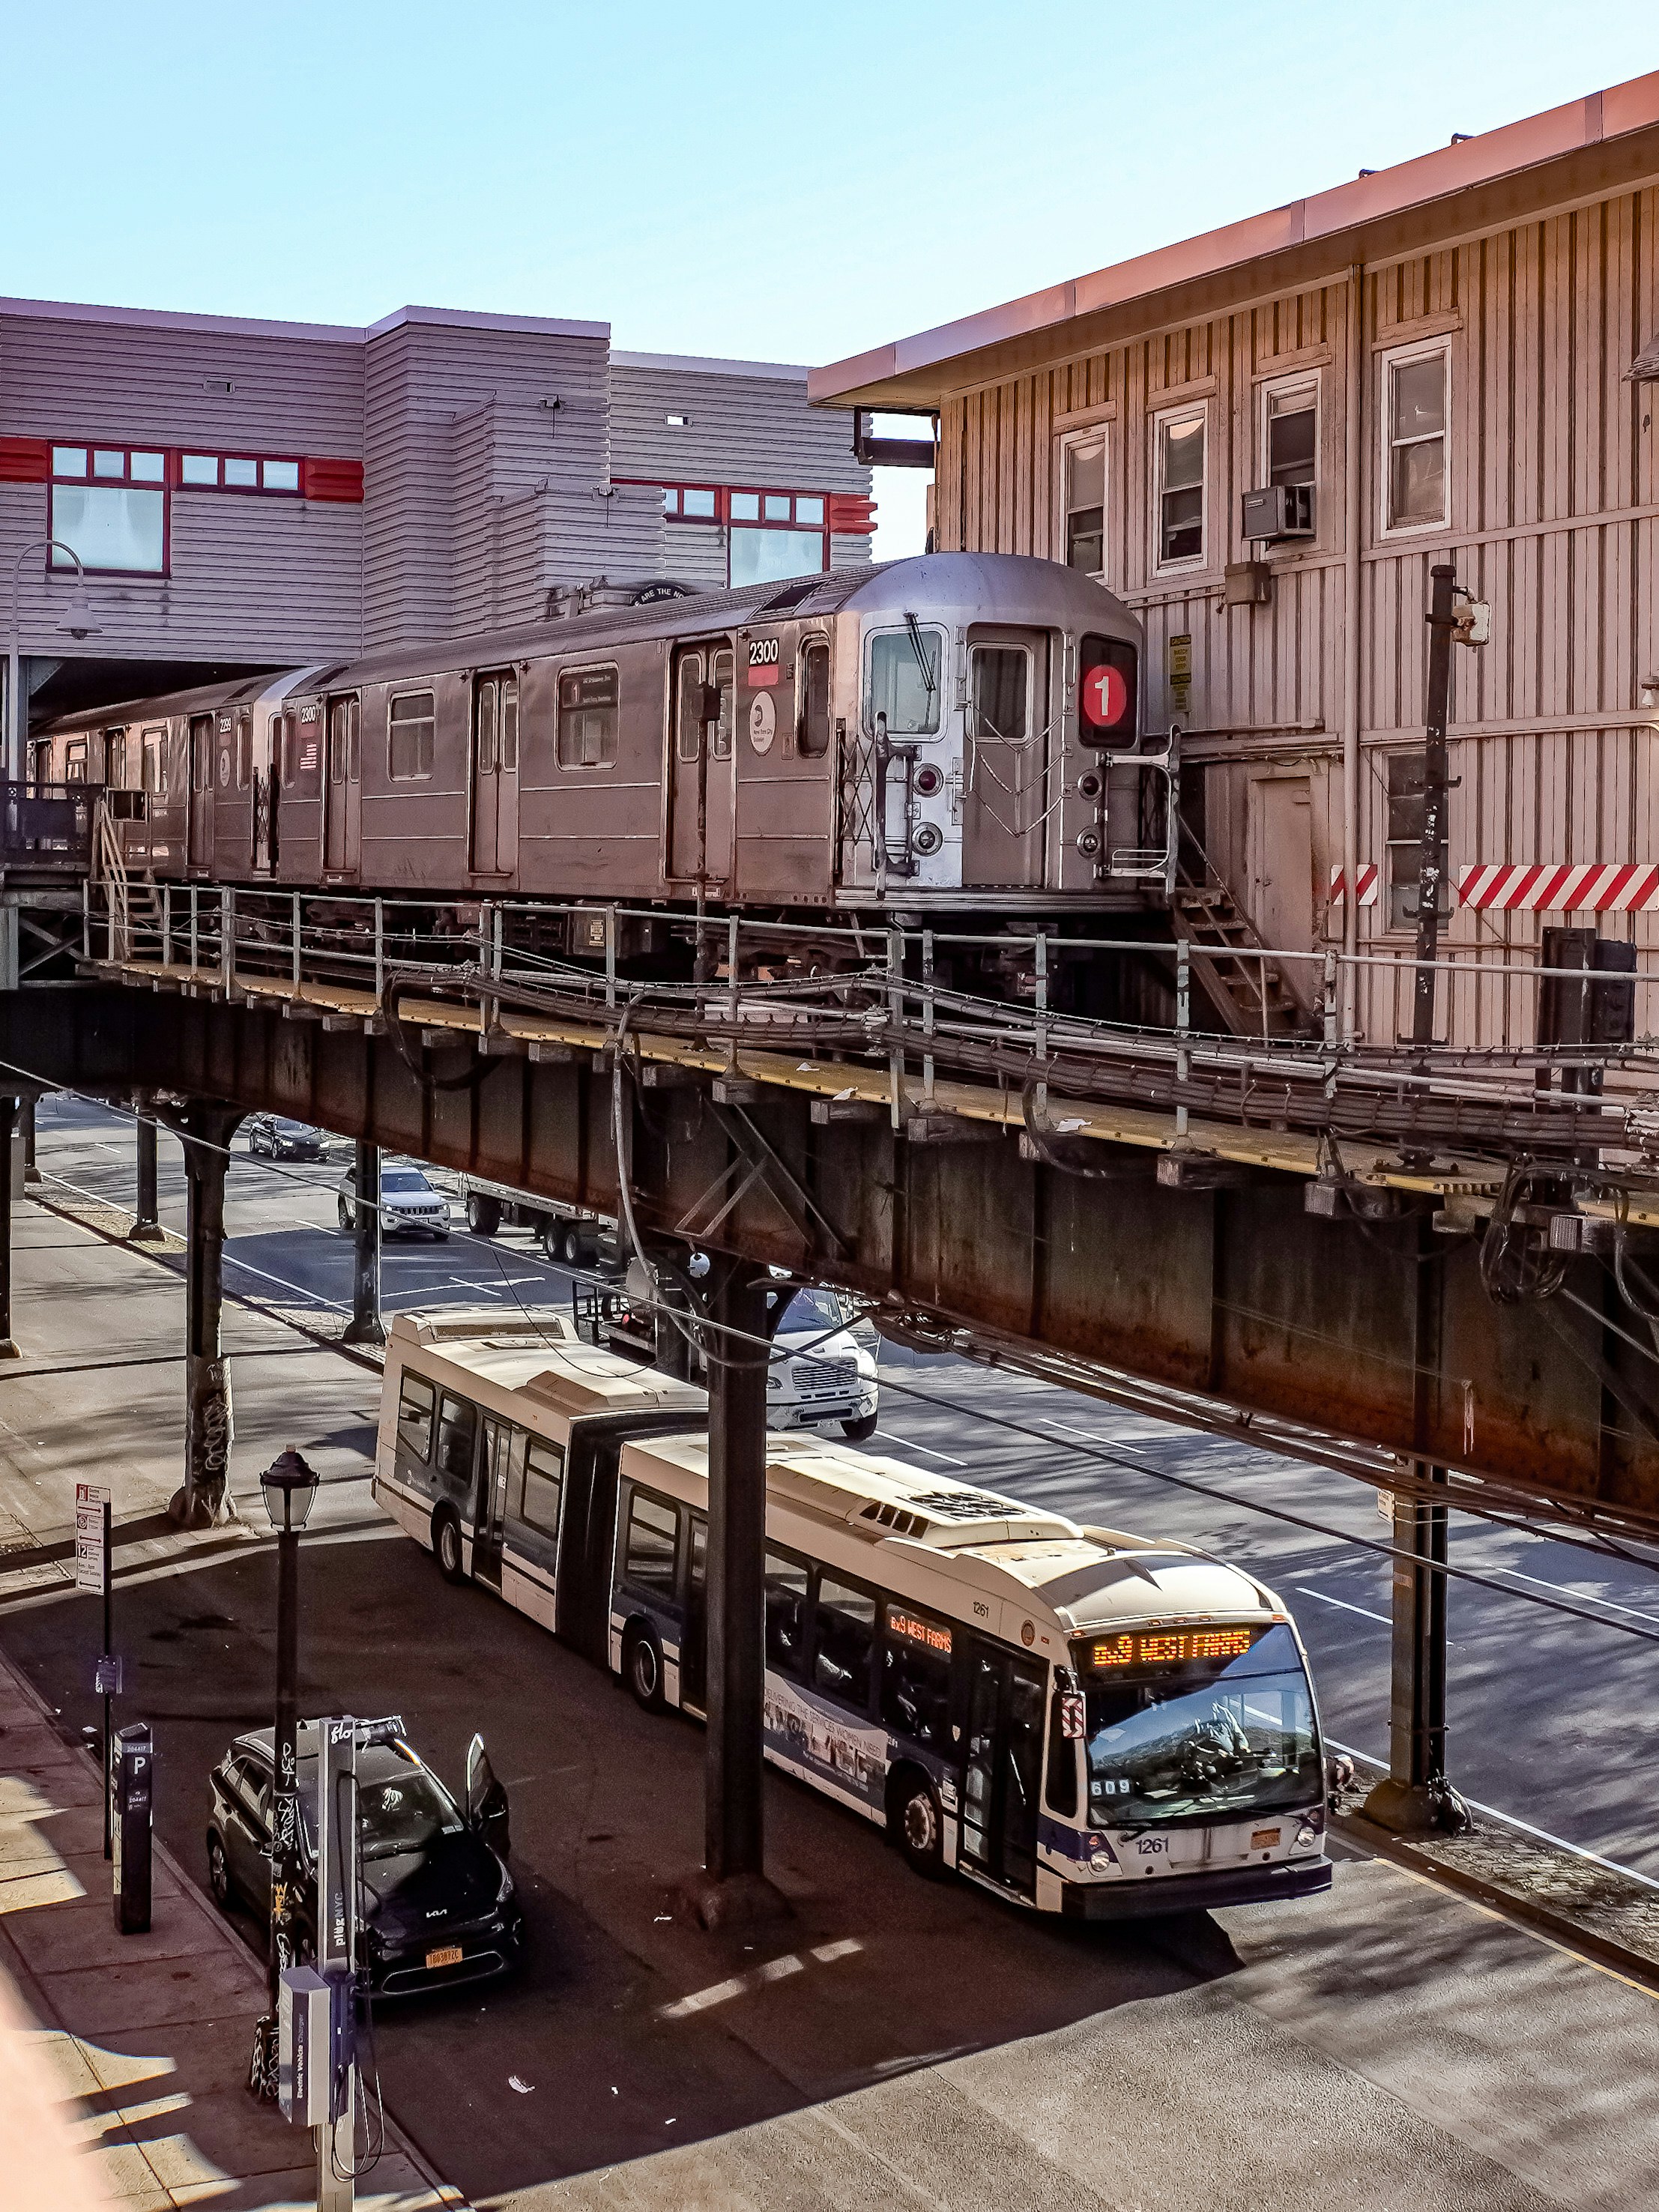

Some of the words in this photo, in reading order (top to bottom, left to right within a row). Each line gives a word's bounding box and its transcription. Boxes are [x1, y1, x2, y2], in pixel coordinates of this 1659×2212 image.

[641, 590, 655, 602] ARE
[749, 638, 779, 665] 2300
[572, 683, 578, 702] 1
[1094, 676, 1109, 716] 1
[301, 706, 316, 723] 2300
[78, 1544, 87, 1558] 12
[973, 1601, 989, 1619] 1261
[890, 1615, 906, 1634] Bx9
[907, 1619, 925, 1642] WEST
[927, 1628, 952, 1655] FARMS
[1140, 1635, 1189, 1663] WEST
[1192, 1630, 1251, 1659] FARMS
[330, 1723, 353, 1744] flo
[134, 1756, 146, 1774] P
[1135, 1837, 1169, 1855] 1261
